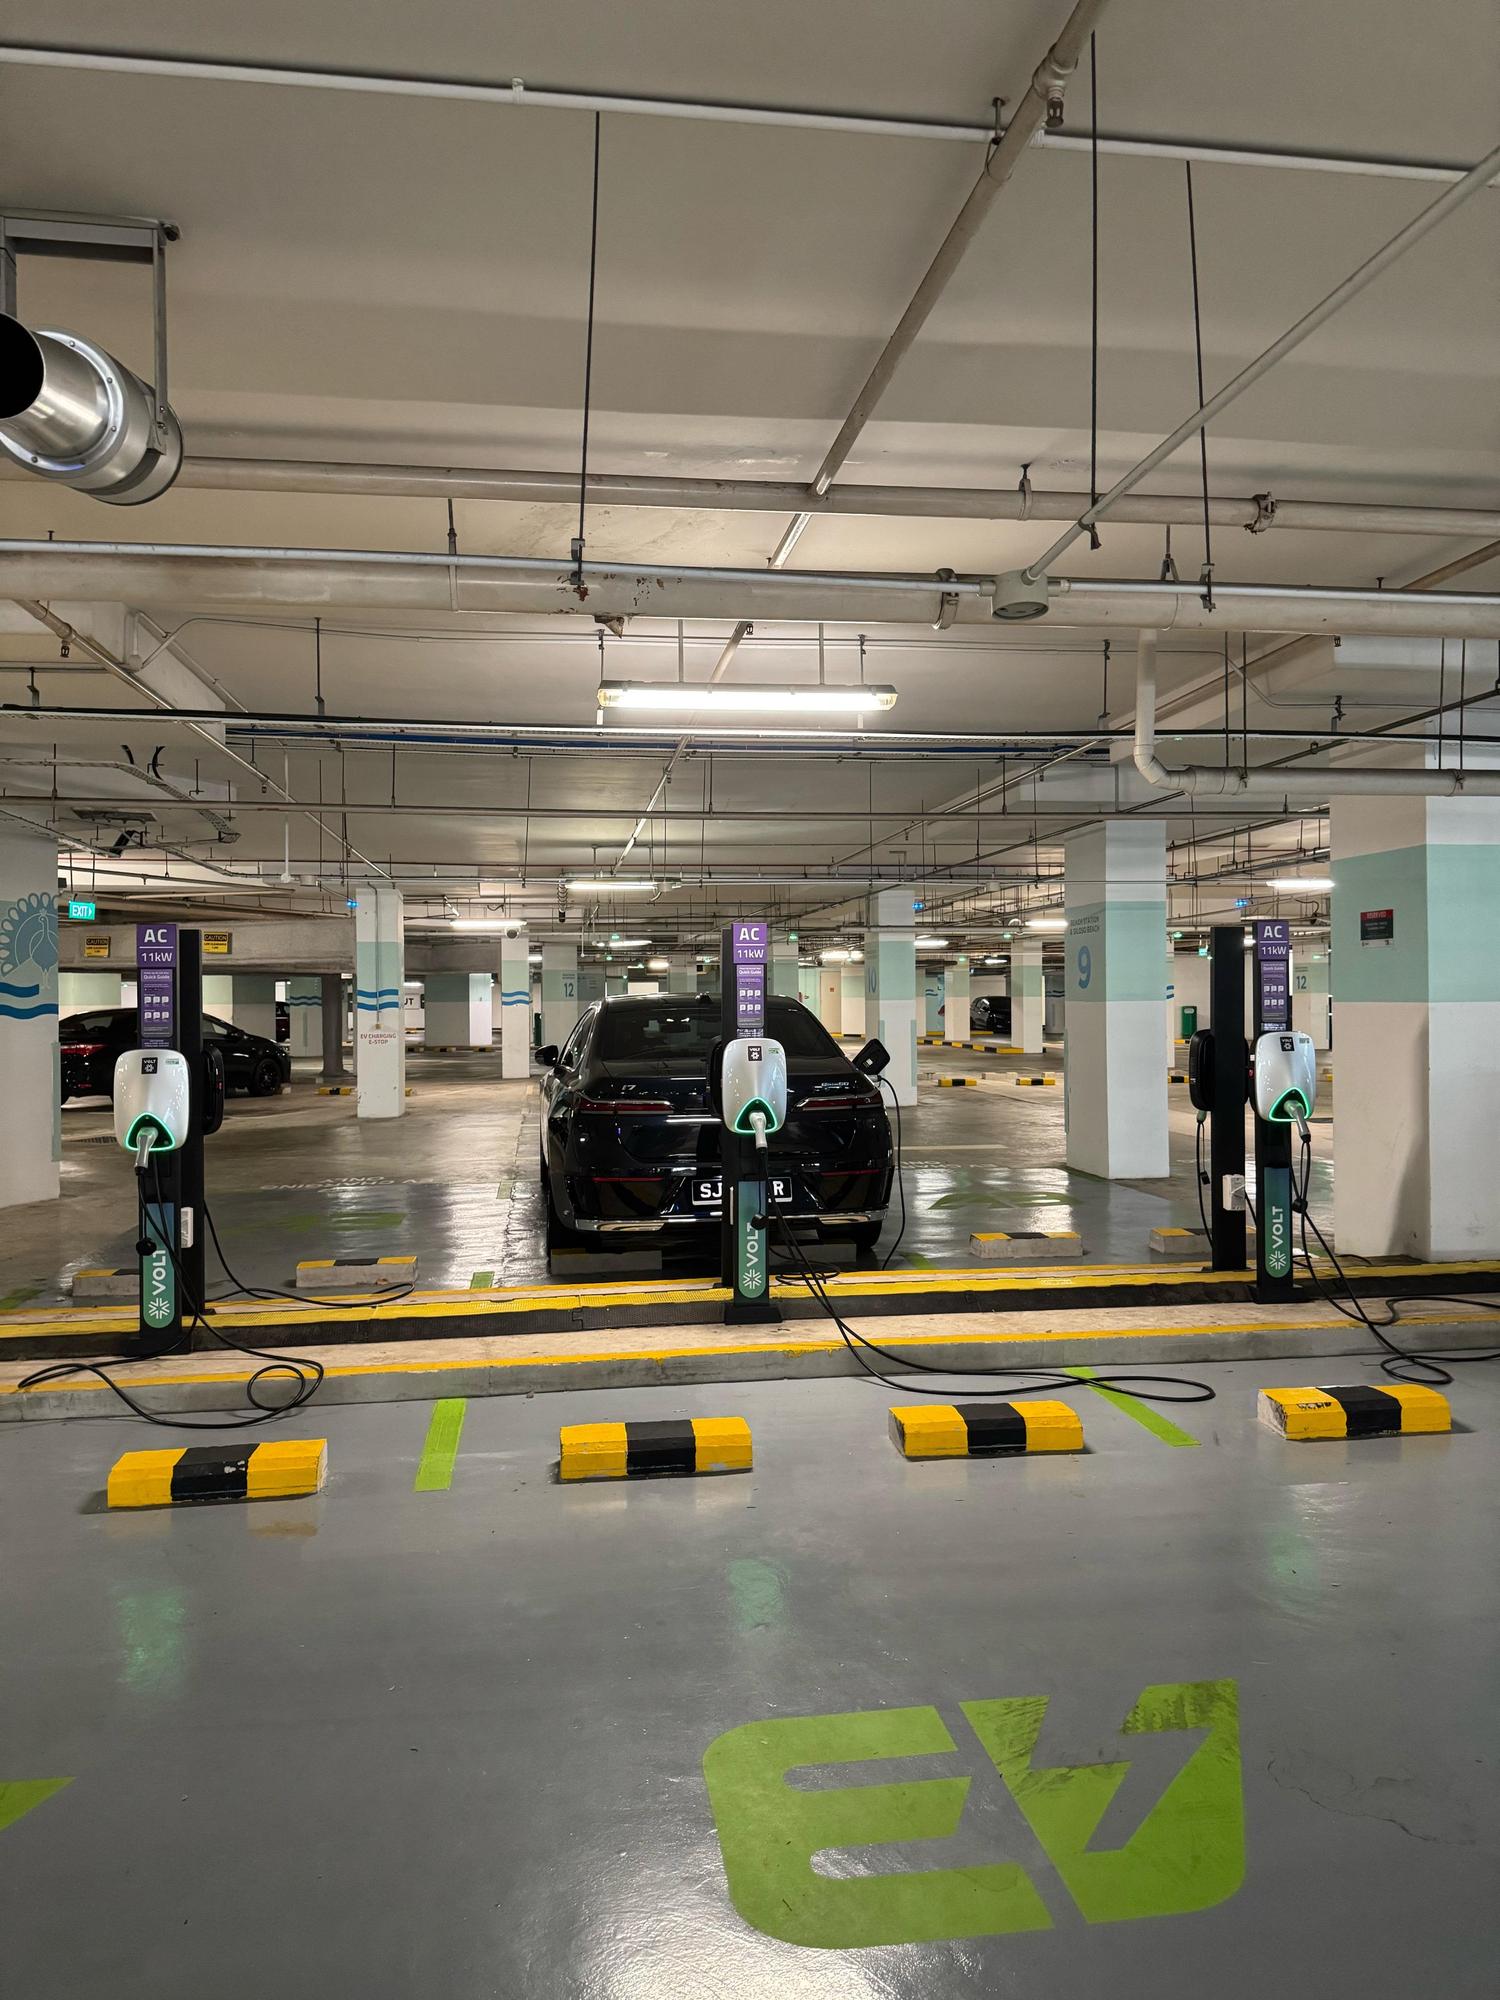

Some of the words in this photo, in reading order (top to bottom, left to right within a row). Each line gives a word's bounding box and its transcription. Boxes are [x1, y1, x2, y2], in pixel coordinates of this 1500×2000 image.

[72, 905, 87, 917] EXIT
[144, 928, 168, 943] AC
[739, 927, 760, 941] AC
[1263, 925, 1283, 938] AC
[141, 952, 172, 962] 11kW
[737, 949, 764, 959] 11kW
[1261, 945, 1287, 955] 11kW
[1078, 945, 1091, 990] 9
[868, 966, 877, 993] 10
[1296, 975, 1307, 990] 12
[564, 982, 575, 998] 12
[1271, 1205, 1284, 1249] VOLT
[702, 1677, 1246, 1950] EV
